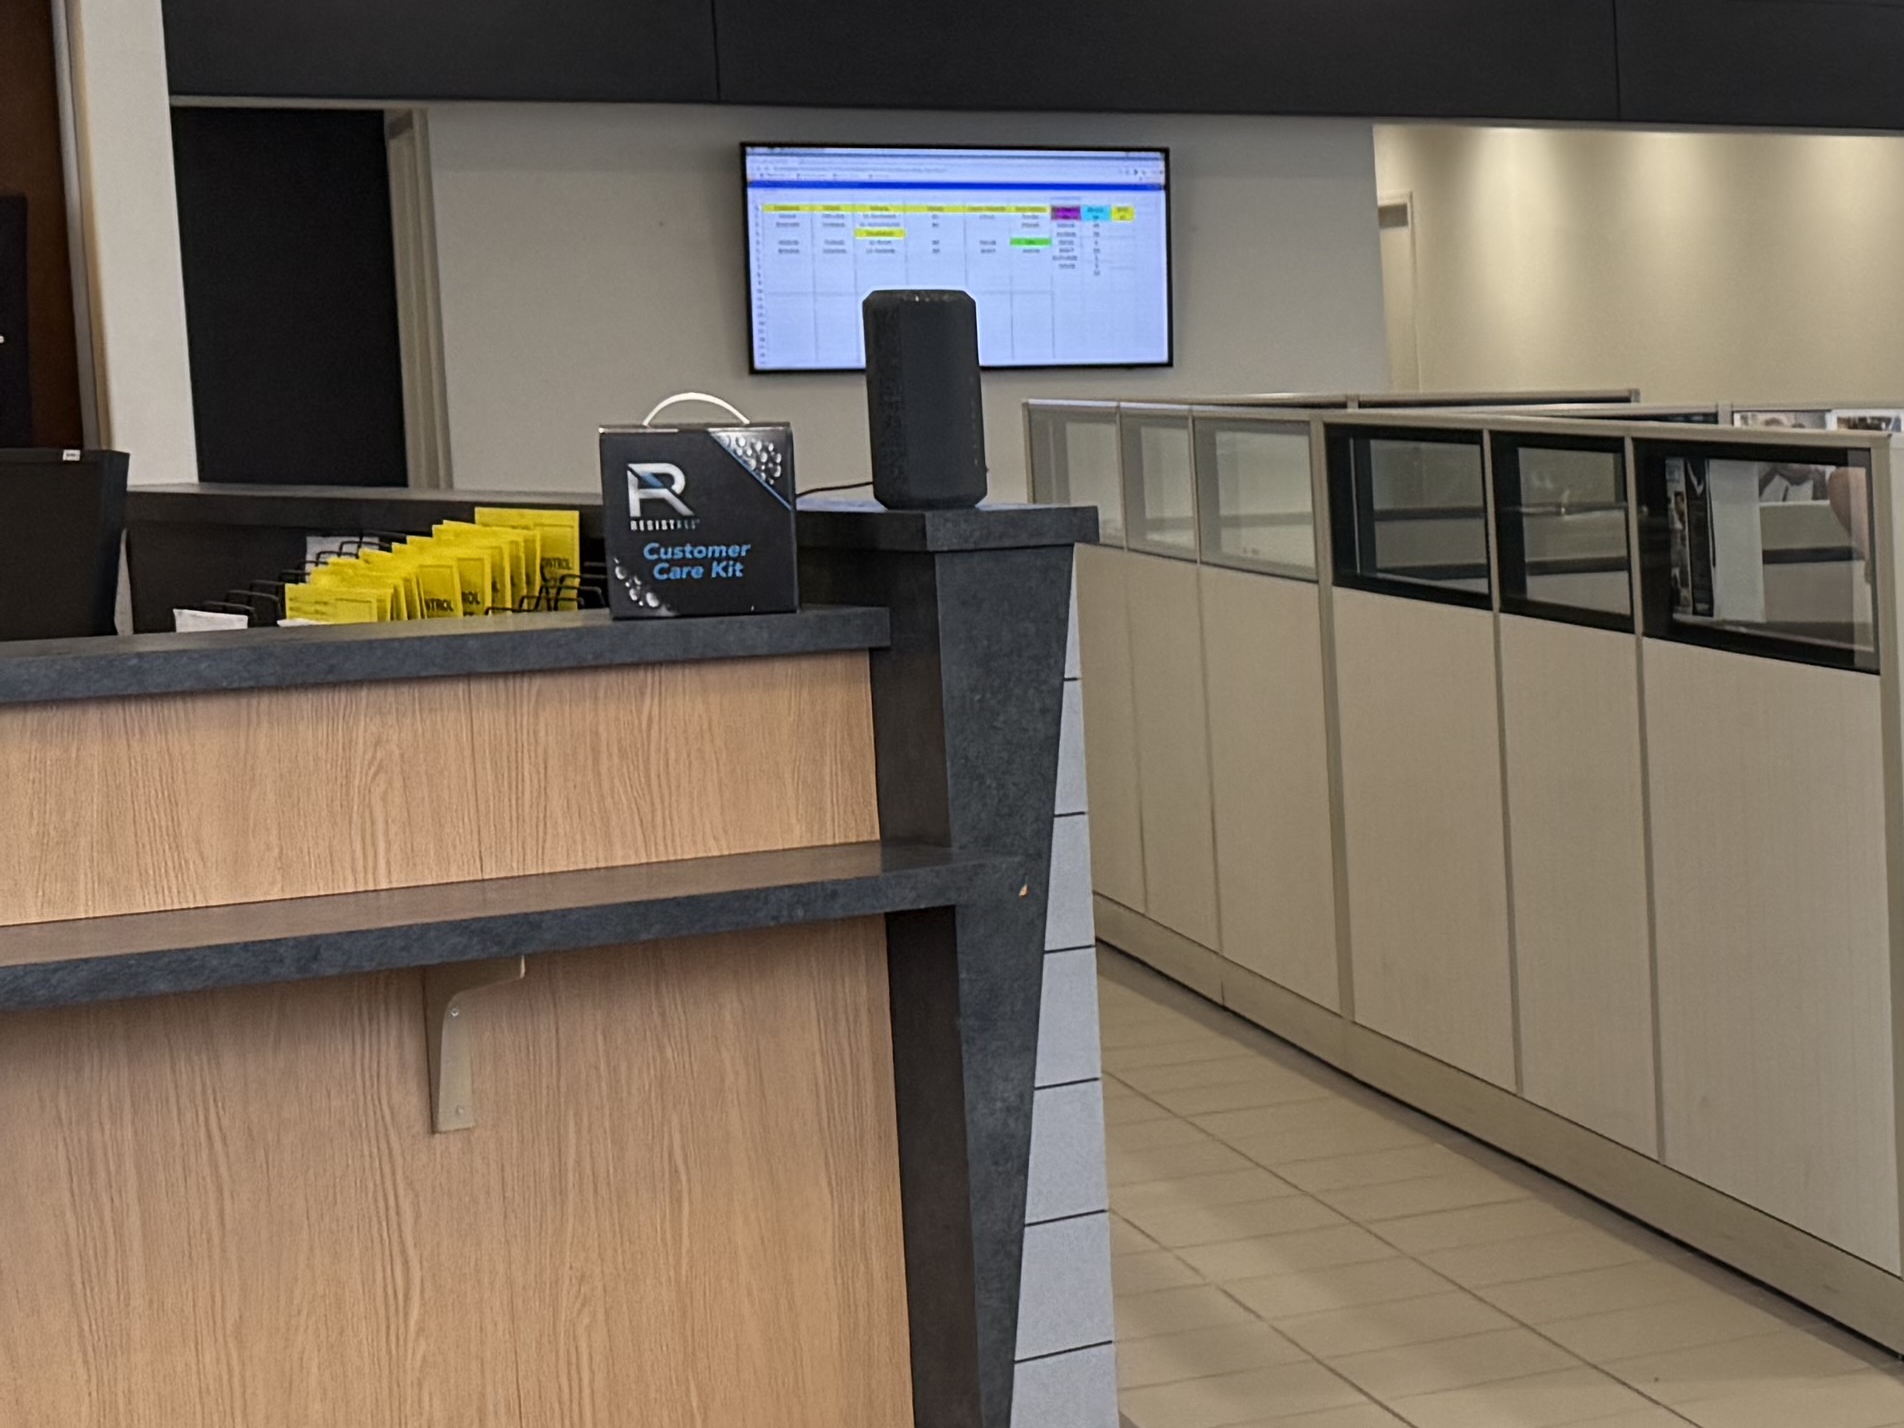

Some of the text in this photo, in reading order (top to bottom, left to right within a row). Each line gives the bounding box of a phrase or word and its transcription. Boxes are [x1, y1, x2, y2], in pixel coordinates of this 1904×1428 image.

[643, 543, 751, 560] Customer
[653, 560, 744, 580] Care Kit
